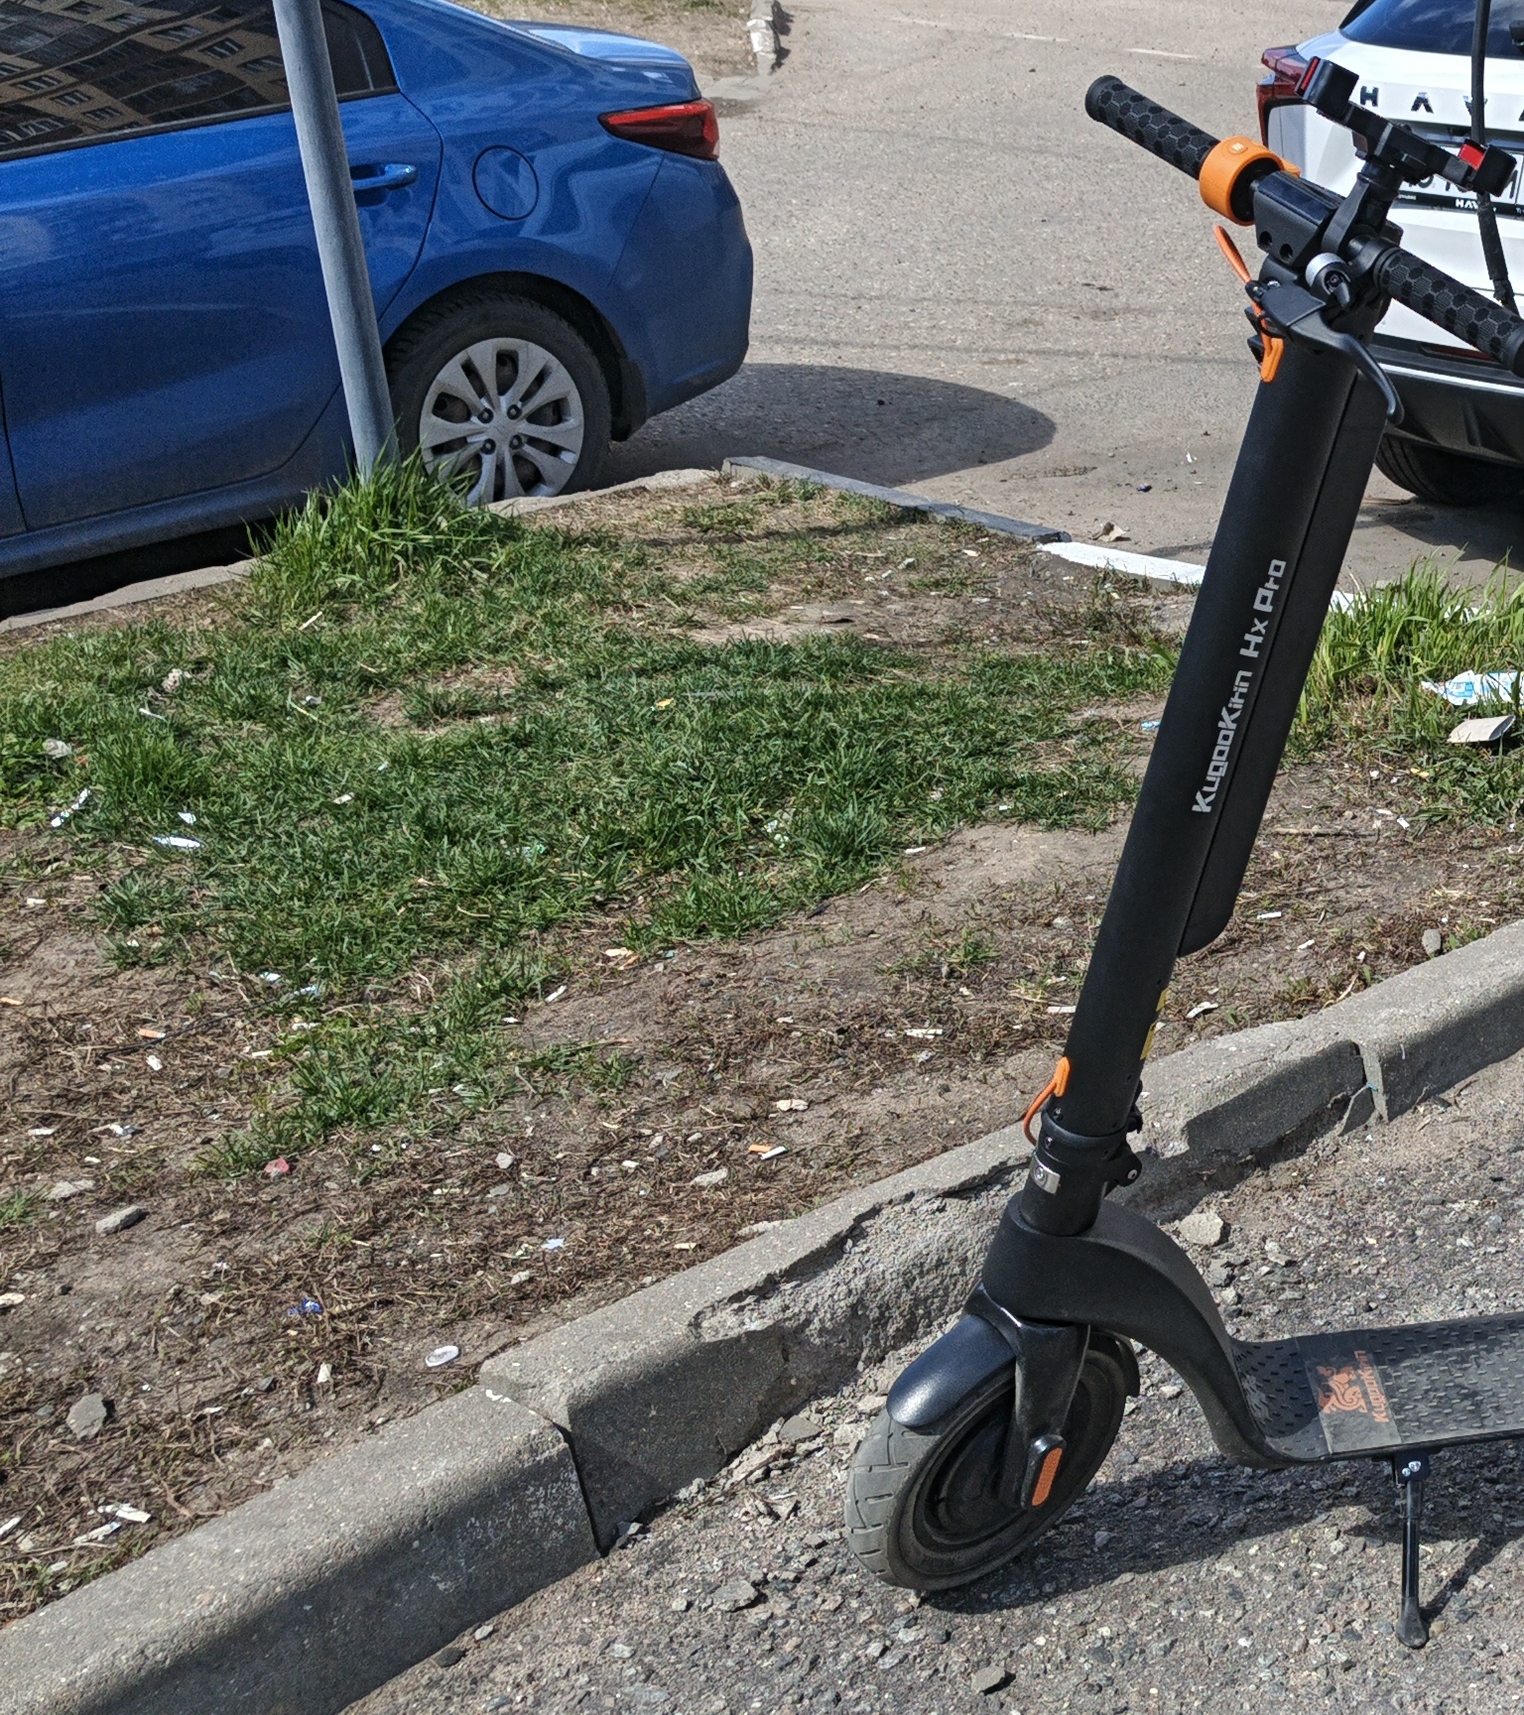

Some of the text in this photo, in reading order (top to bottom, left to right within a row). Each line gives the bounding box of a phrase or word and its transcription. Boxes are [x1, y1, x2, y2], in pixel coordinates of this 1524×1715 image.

[1192, 559, 1286, 812] KugooKirin Hx Pro
